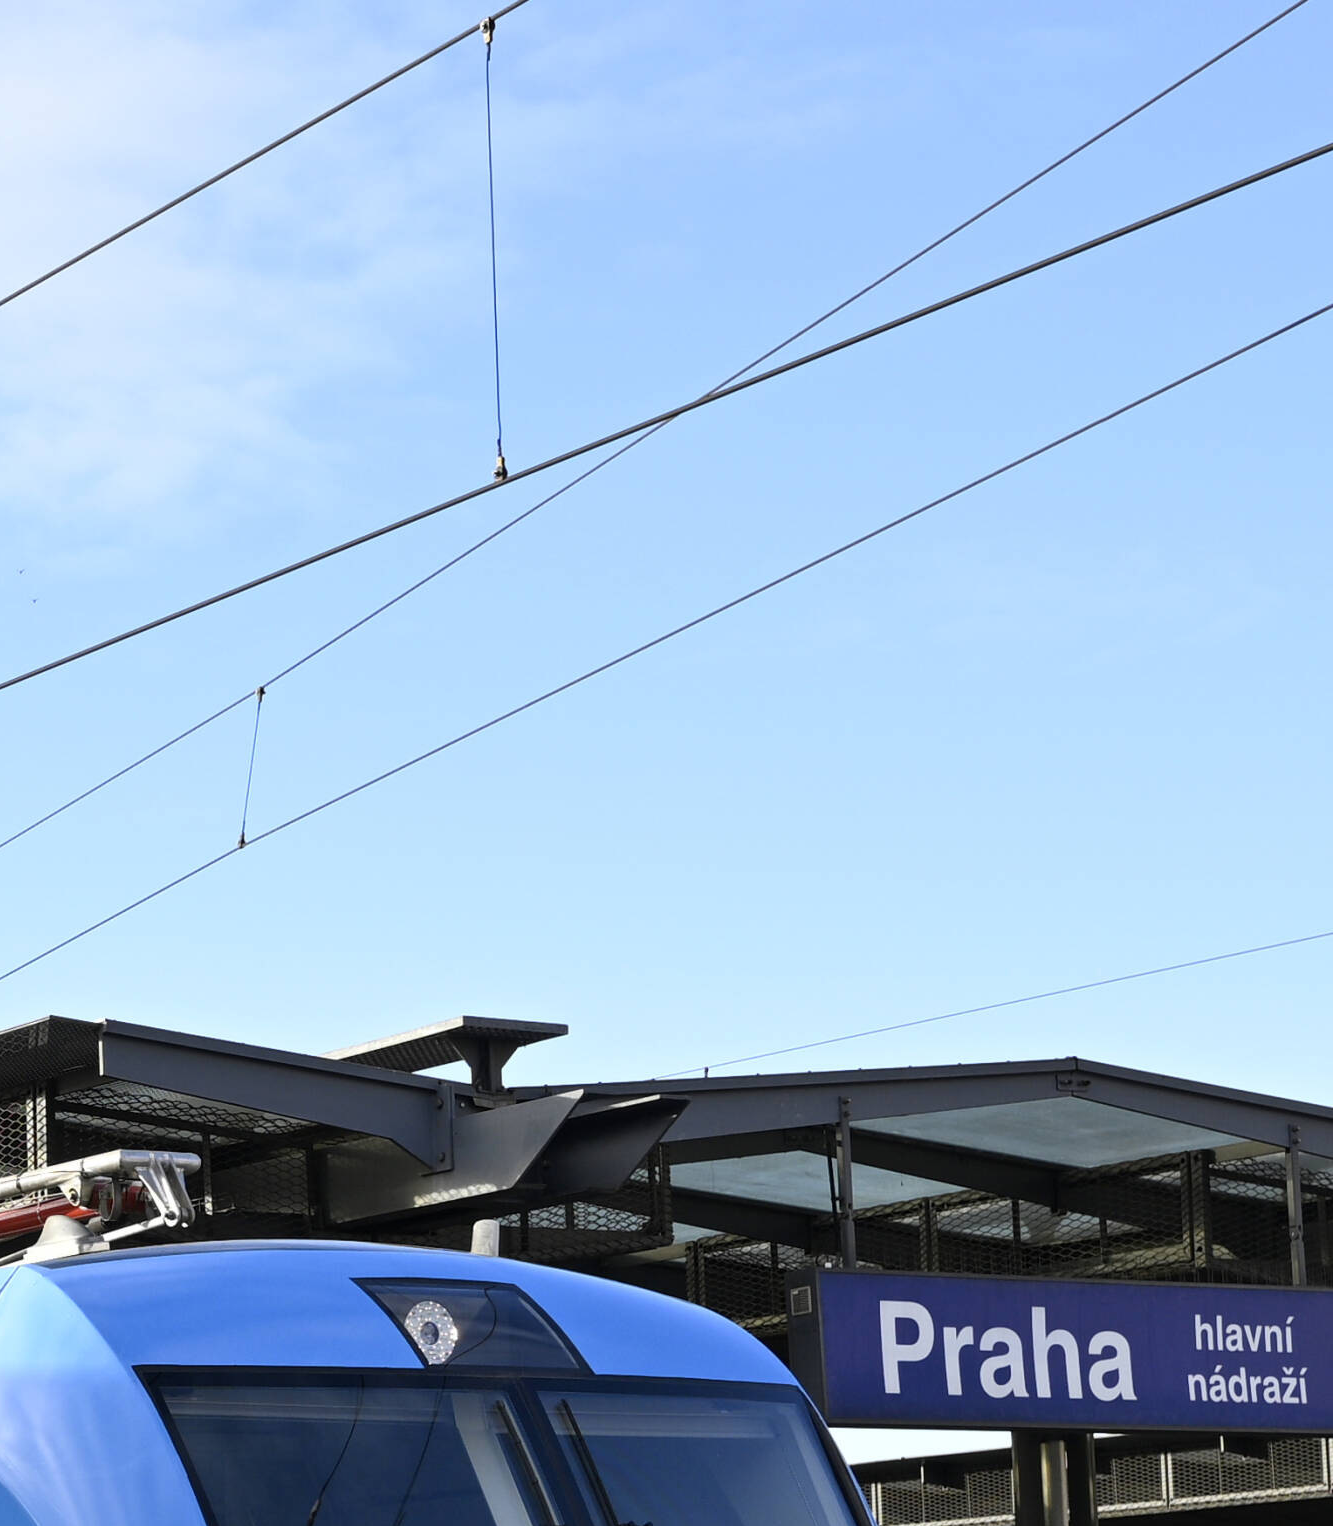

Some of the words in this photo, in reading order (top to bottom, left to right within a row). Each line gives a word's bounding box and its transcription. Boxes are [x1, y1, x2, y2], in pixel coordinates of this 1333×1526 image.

[879, 1300, 1137, 1401] Praha
[1194, 1314, 1294, 1354] hlavní
[1188, 1364, 1308, 1405] nádraží
